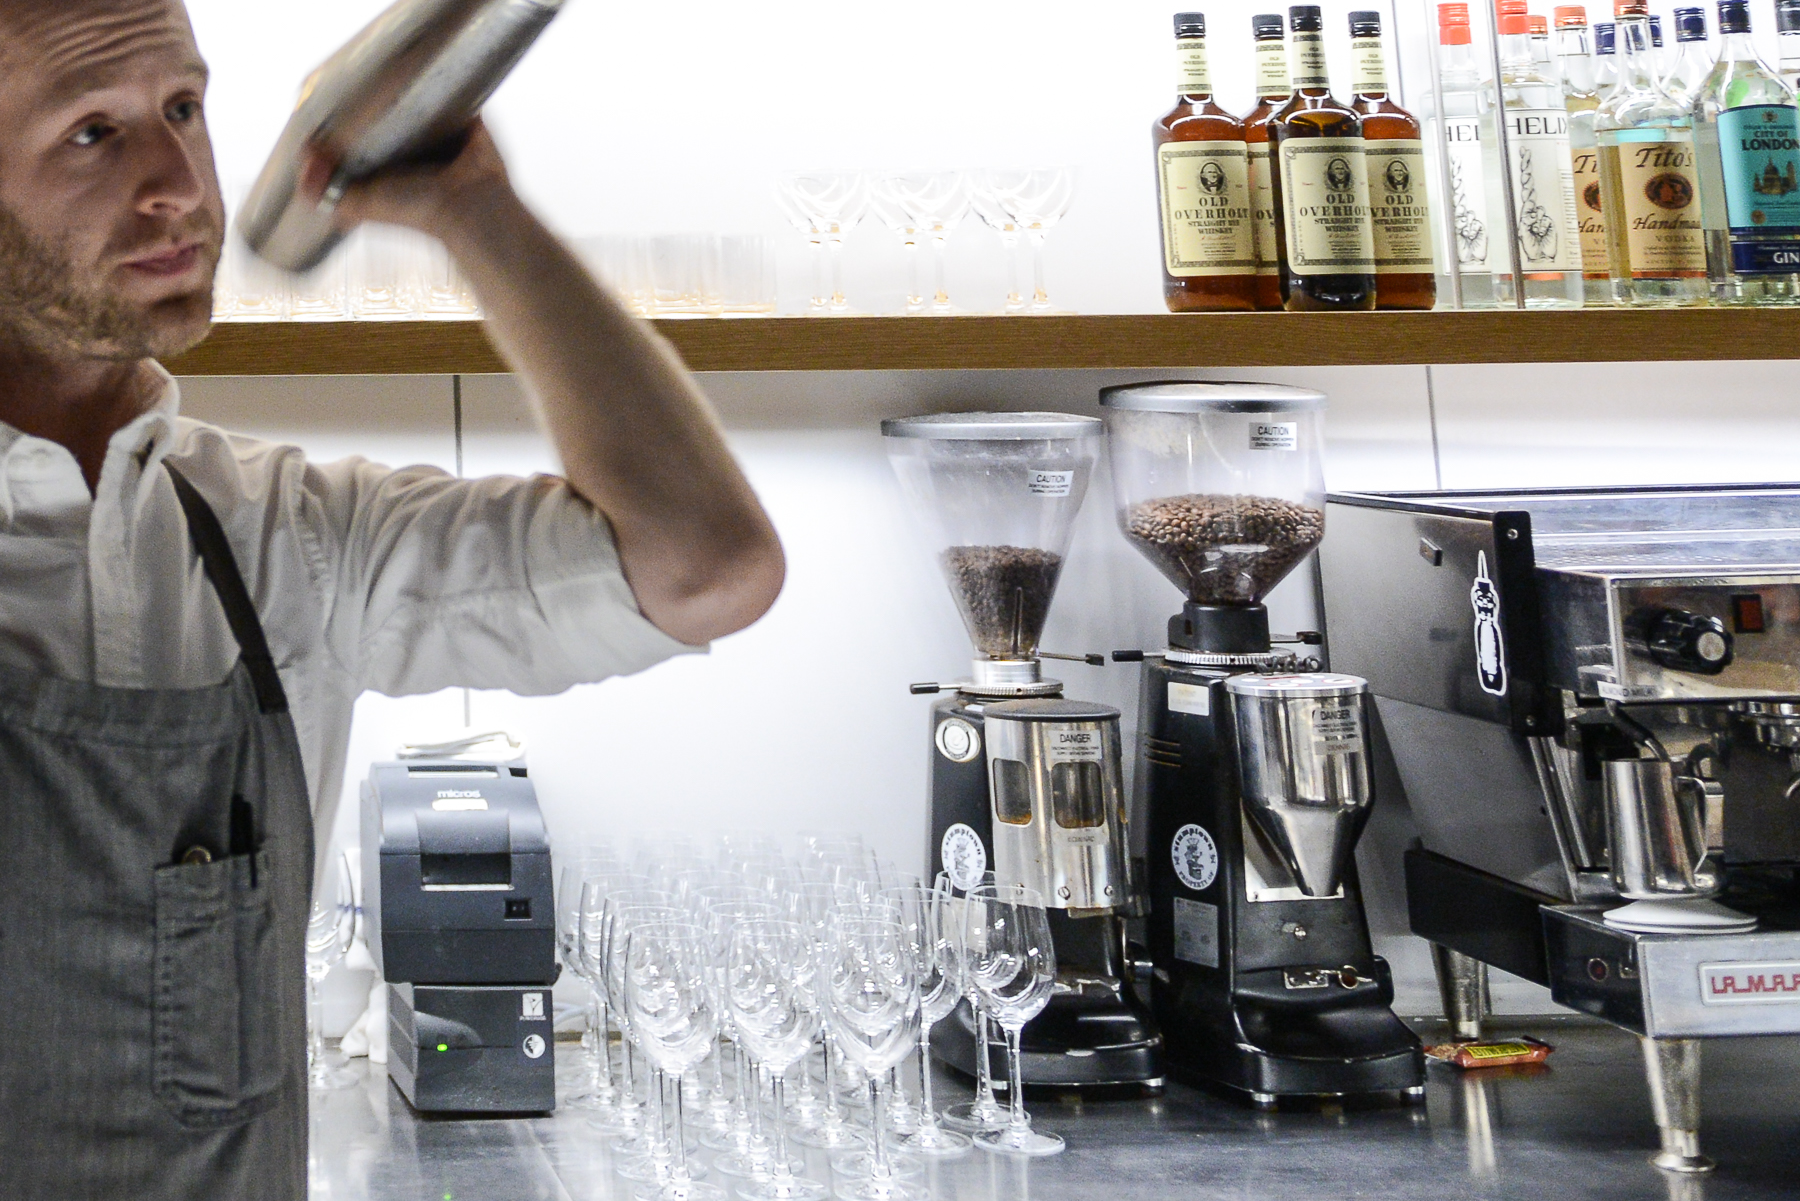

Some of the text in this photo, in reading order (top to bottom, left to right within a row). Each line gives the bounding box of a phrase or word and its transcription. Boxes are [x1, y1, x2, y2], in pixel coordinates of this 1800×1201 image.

[1754, 130, 1788, 138] CITY OF
[1635, 145, 1692, 168] Tito's
[1199, 197, 1228, 207] OLD
[1326, 194, 1355, 205] OLD
[1385, 195, 1413, 205] OLD
[1174, 208, 1248, 220] OVERHOLT
[1773, 252, 1800, 264] GIN
[1257, 426, 1289, 435] CAUTION
[1036, 474, 1066, 483] CAUTION
[1320, 709, 1351, 720] DANGER
[1060, 733, 1091, 743] DANGER
[437, 789, 481, 798] micros
